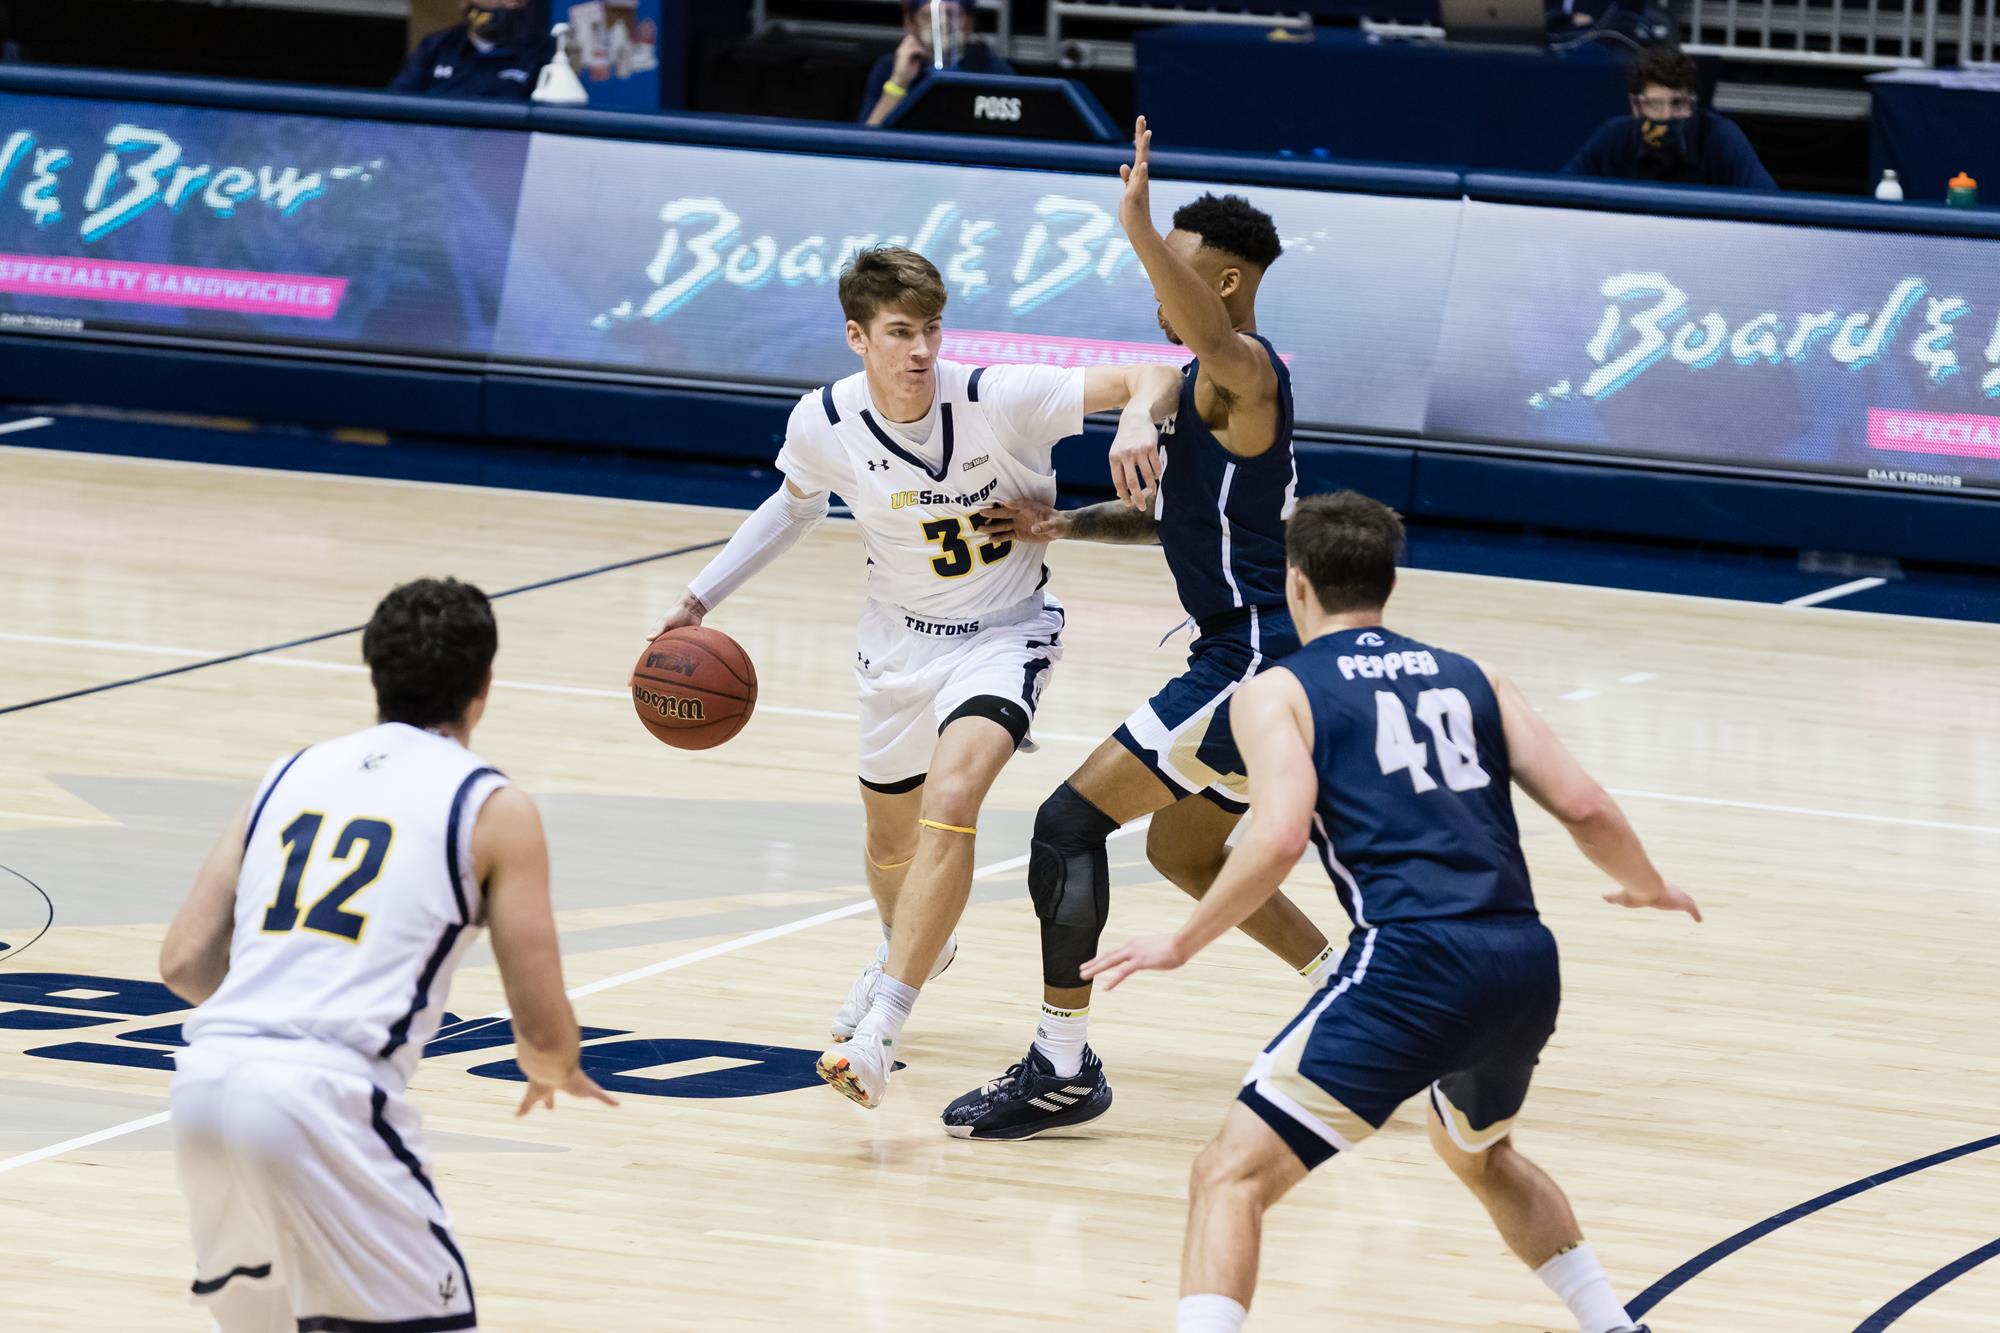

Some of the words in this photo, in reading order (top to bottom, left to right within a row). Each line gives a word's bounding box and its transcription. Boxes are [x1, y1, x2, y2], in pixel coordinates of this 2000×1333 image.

[974, 95, 1022, 121] POSS
[81, 124, 327, 243] Brew
[1008, 194, 1150, 315] Br
[145, 273, 332, 306] SANDWICHES
[942, 336, 1075, 366] PECIALTY
[1582, 271, 1928, 400] Board
[1866, 468, 1962, 487] DAKTRONICS
[905, 616, 980, 636] TRITONS
[1337, 650, 1439, 680] PEPPER
[634, 684, 706, 720] Wilson
[1374, 687, 1492, 794] 40
[259, 809, 396, 944] 12
